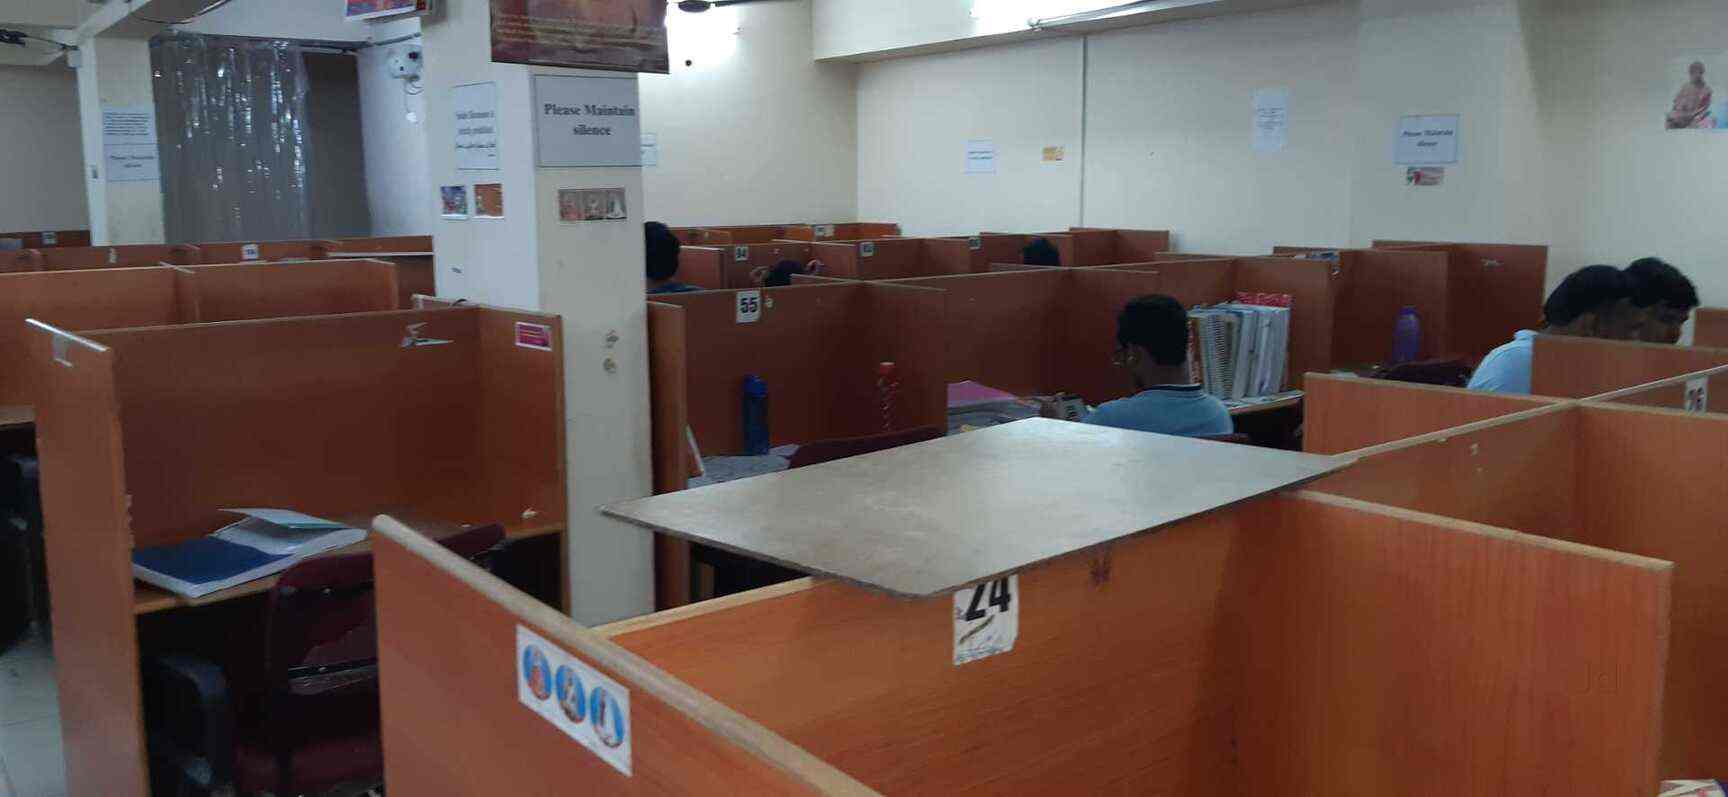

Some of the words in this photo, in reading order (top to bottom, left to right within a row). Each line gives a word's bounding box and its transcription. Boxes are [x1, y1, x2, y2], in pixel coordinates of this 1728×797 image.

[543, 103, 581, 116] Please
[584, 104, 635, 116] Maintain
[572, 123, 612, 136] silence
[740, 296, 758, 313] 55
[964, 577, 1011, 622] 24
